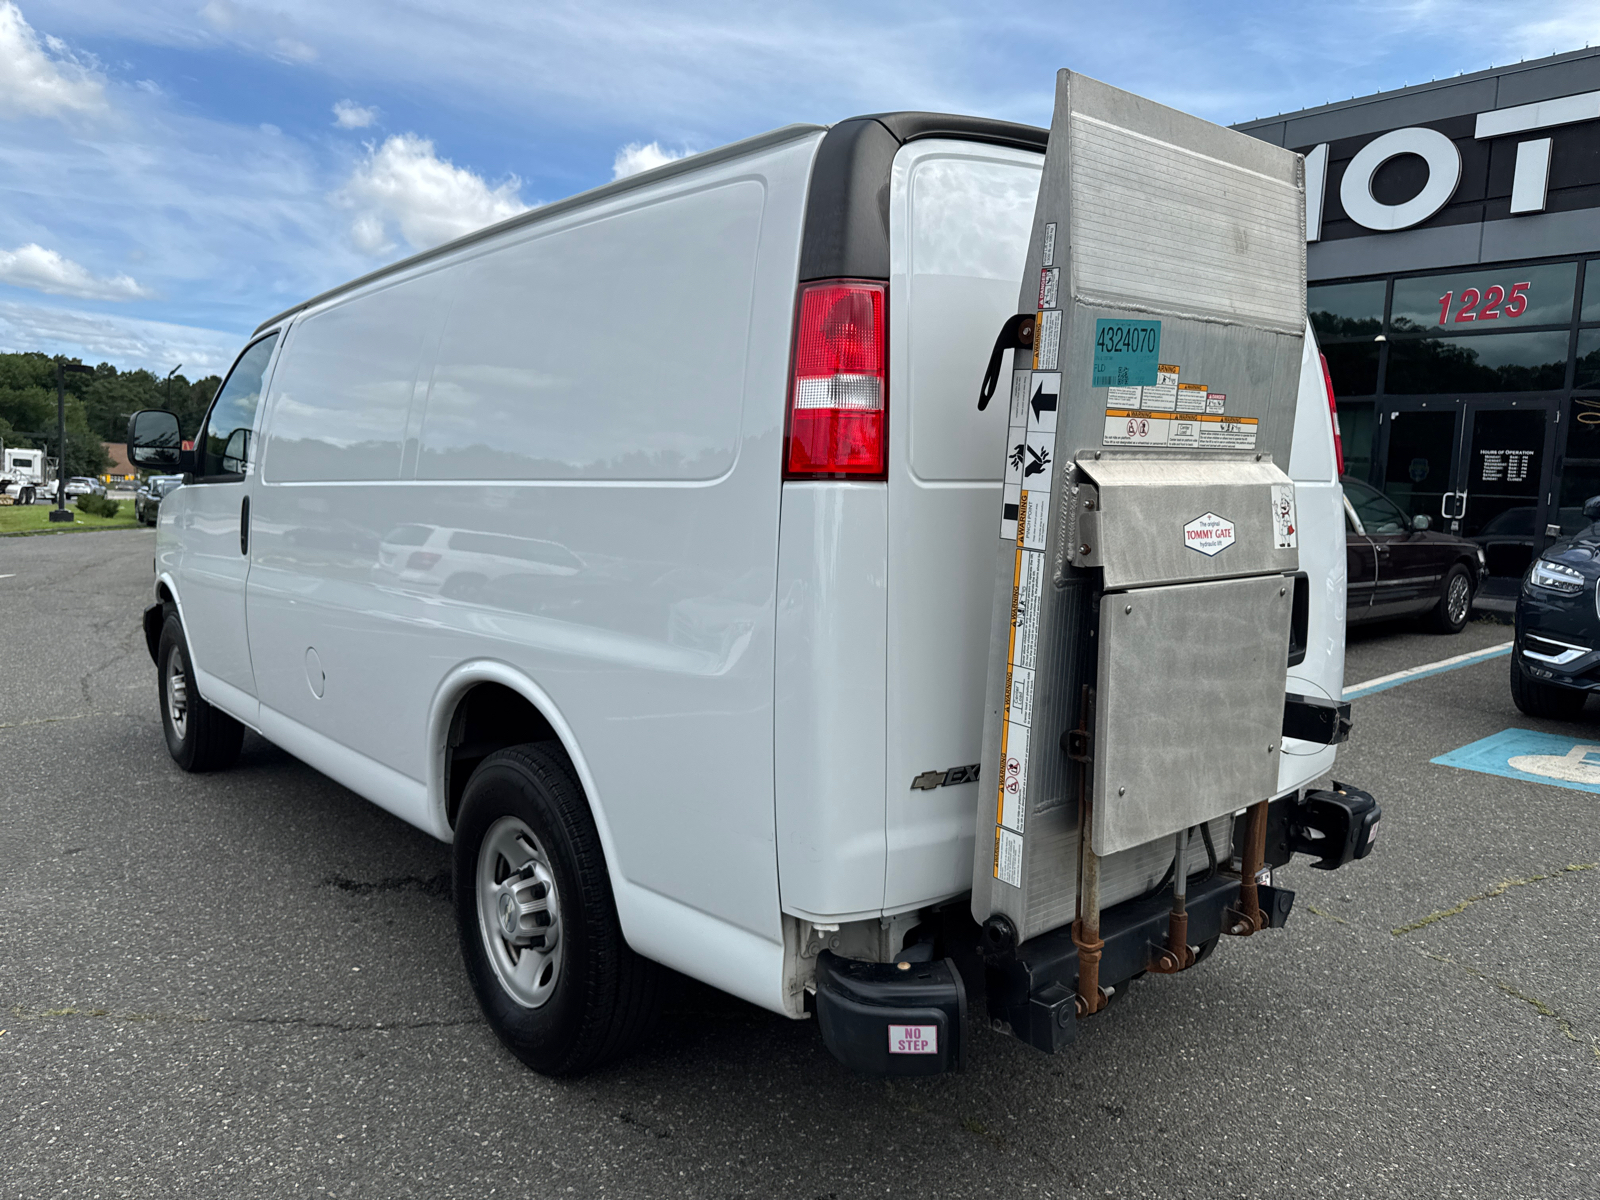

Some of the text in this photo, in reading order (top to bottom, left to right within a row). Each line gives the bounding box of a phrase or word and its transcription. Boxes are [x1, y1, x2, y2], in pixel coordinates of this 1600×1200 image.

[1438, 281, 1530, 325] 1225
[1097, 326, 1156, 352] 4324070
[1094, 364, 1106, 372] FLD
[1018, 495, 1027, 535] WARNING
[1186, 529, 1232, 540] TOMMY GATE
[943, 764, 980, 786] EX
[905, 1028, 921, 1039] NO
[898, 1040, 928, 1051] STEP
